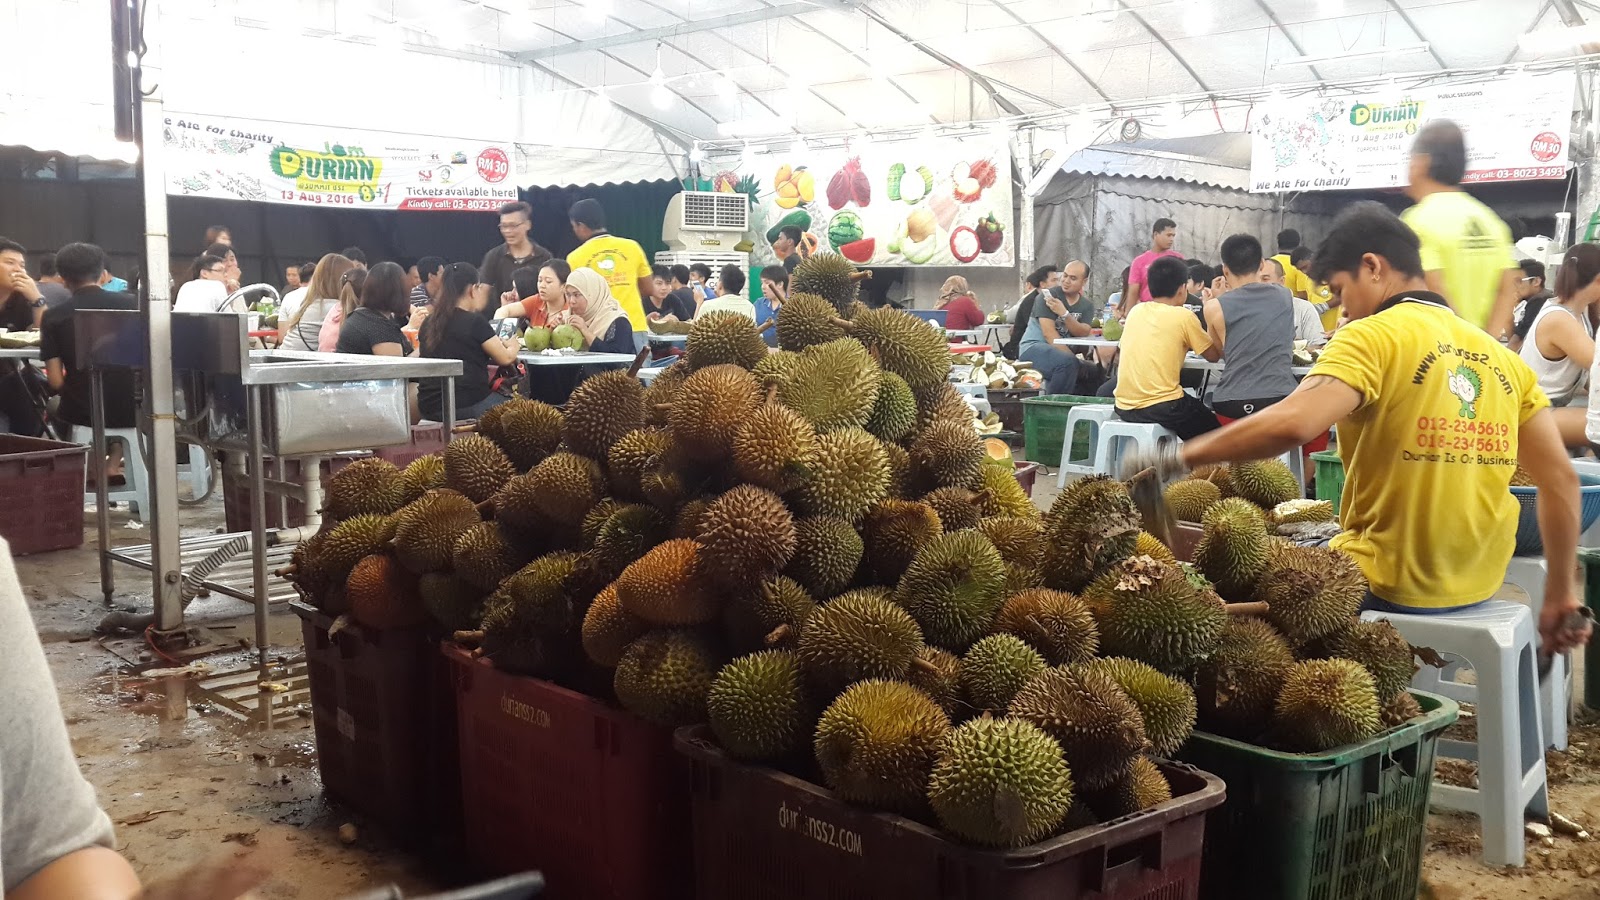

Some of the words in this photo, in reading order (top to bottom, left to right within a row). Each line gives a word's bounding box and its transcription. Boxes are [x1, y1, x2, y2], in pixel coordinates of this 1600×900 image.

[1350, 102, 1419, 126] DURIAN
[206, 125, 225, 135] For
[230, 130, 274, 143] Charity
[1363, 134, 1380, 142] Aug
[1383, 131, 1404, 140] 2016
[1532, 140, 1547, 151] RM
[1548, 143, 1560, 153] 30
[269, 147, 375, 181] DURIAN
[478, 157, 494, 171] RM
[494, 160, 508, 174] 30
[1496, 168, 1537, 178] 03-8023
[1538, 167, 1563, 176] 3493
[1256, 181, 1270, 189] We
[1274, 180, 1290, 188] Ate
[1294, 179, 1310, 187] For
[1314, 176, 1351, 187] Charity
[281, 190, 294, 199] 13
[299, 192, 322, 203] Aug
[326, 194, 354, 204] 2016
[407, 187, 443, 196] Tickets
[445, 187, 489, 196] available
[491, 188, 516, 197] here!
[407, 199, 433, 208] Kindly
[435, 200, 451, 208] call:
[452, 200, 490, 209] 03-8023
[1417, 416, 1508, 437] 012-2345619
[1444, 453, 1456, 463] Is
